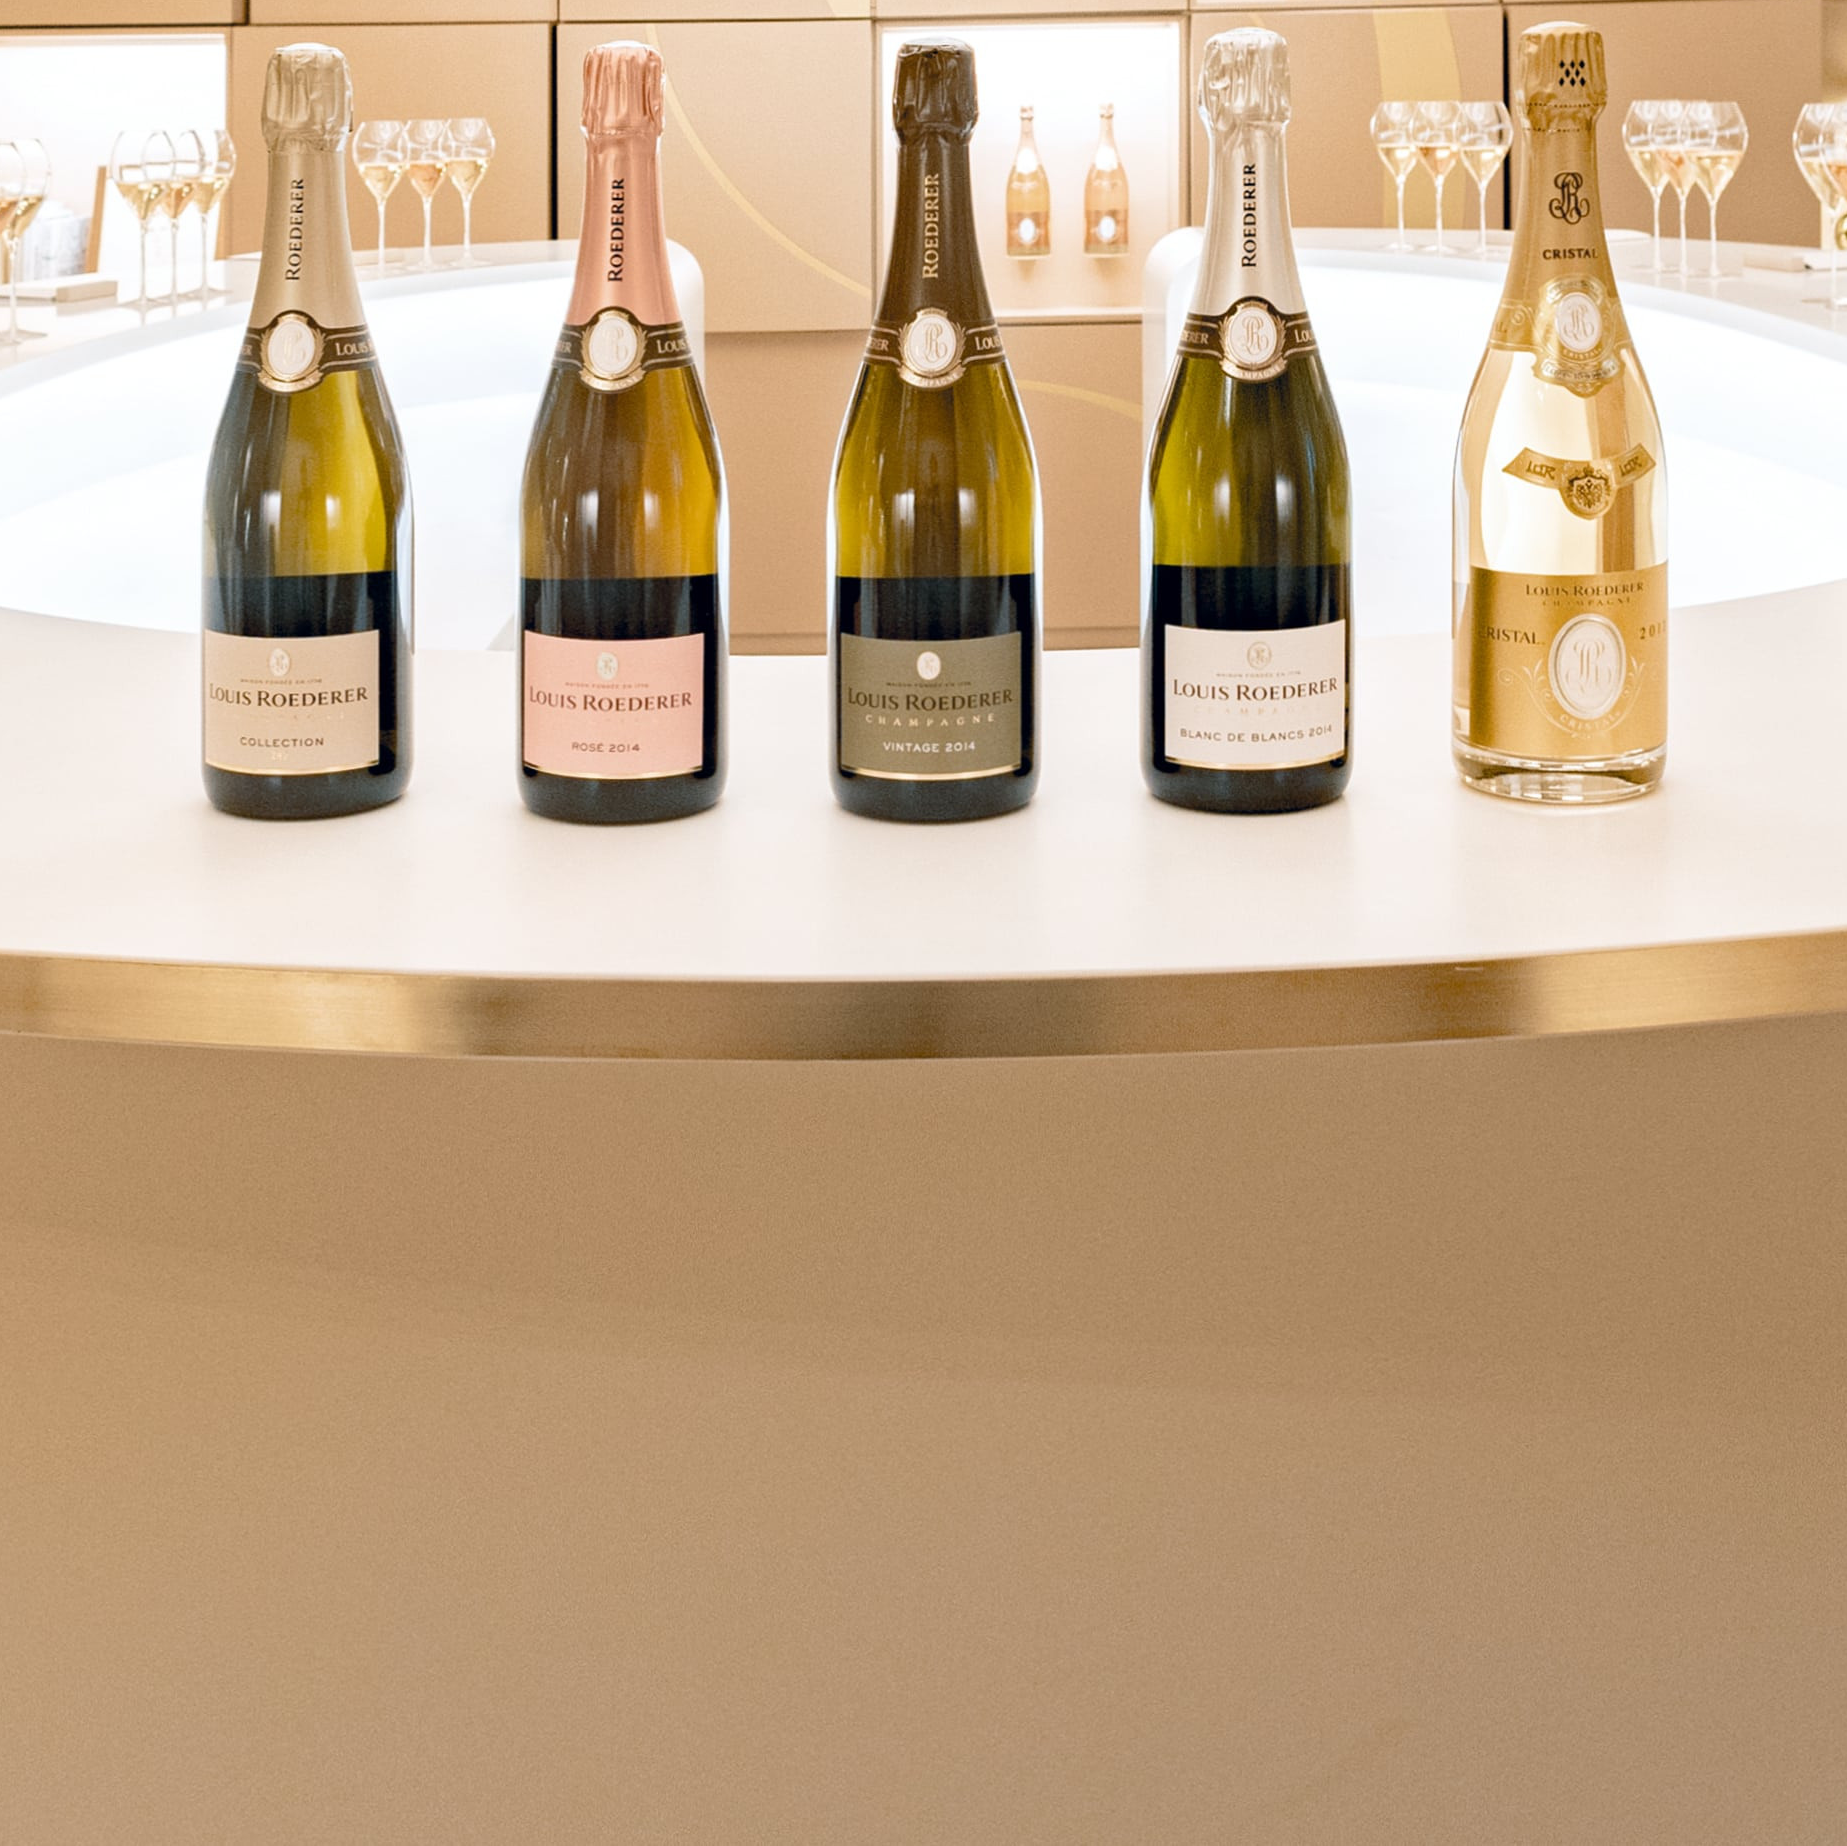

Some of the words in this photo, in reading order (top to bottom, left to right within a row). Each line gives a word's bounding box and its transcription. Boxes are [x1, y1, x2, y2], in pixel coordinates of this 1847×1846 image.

[922, 172, 939, 279] ROEDERER
[1242, 163, 1257, 268] ROEDERER
[284, 177, 304, 281] ROEDERER
[607, 177, 626, 282] ROEDERER
[1542, 248, 1598, 260] CRISTAL
[1525, 583, 1569, 596] LOUIS
[1573, 581, 1644, 596] ROEDERER
[209, 682, 252, 706] LOUIS
[257, 686, 369, 707] ROEDERER
[529, 685, 576, 710] LOUIS
[582, 691, 692, 712] ROEDERER
[848, 687, 899, 710] LOUIS
[905, 688, 1013, 711] ROEDERER
[1173, 678, 1230, 700] LOUIS
[1236, 677, 1338, 701] ROEDERER
[865, 713, 995, 727] CHAMPAGNE
[239, 736, 324, 748] COLLECTION
[1180, 728, 1222, 742] BLANC
[1227, 732, 1245, 742] DE
[1251, 730, 1305, 742] BLANCS
[1308, 724, 1333, 737] 2014
[571, 741, 604, 752] ROSÉ
[608, 743, 640, 753] 2014
[883, 742, 940, 753] VINTAGE
[945, 741, 976, 752] 2014
